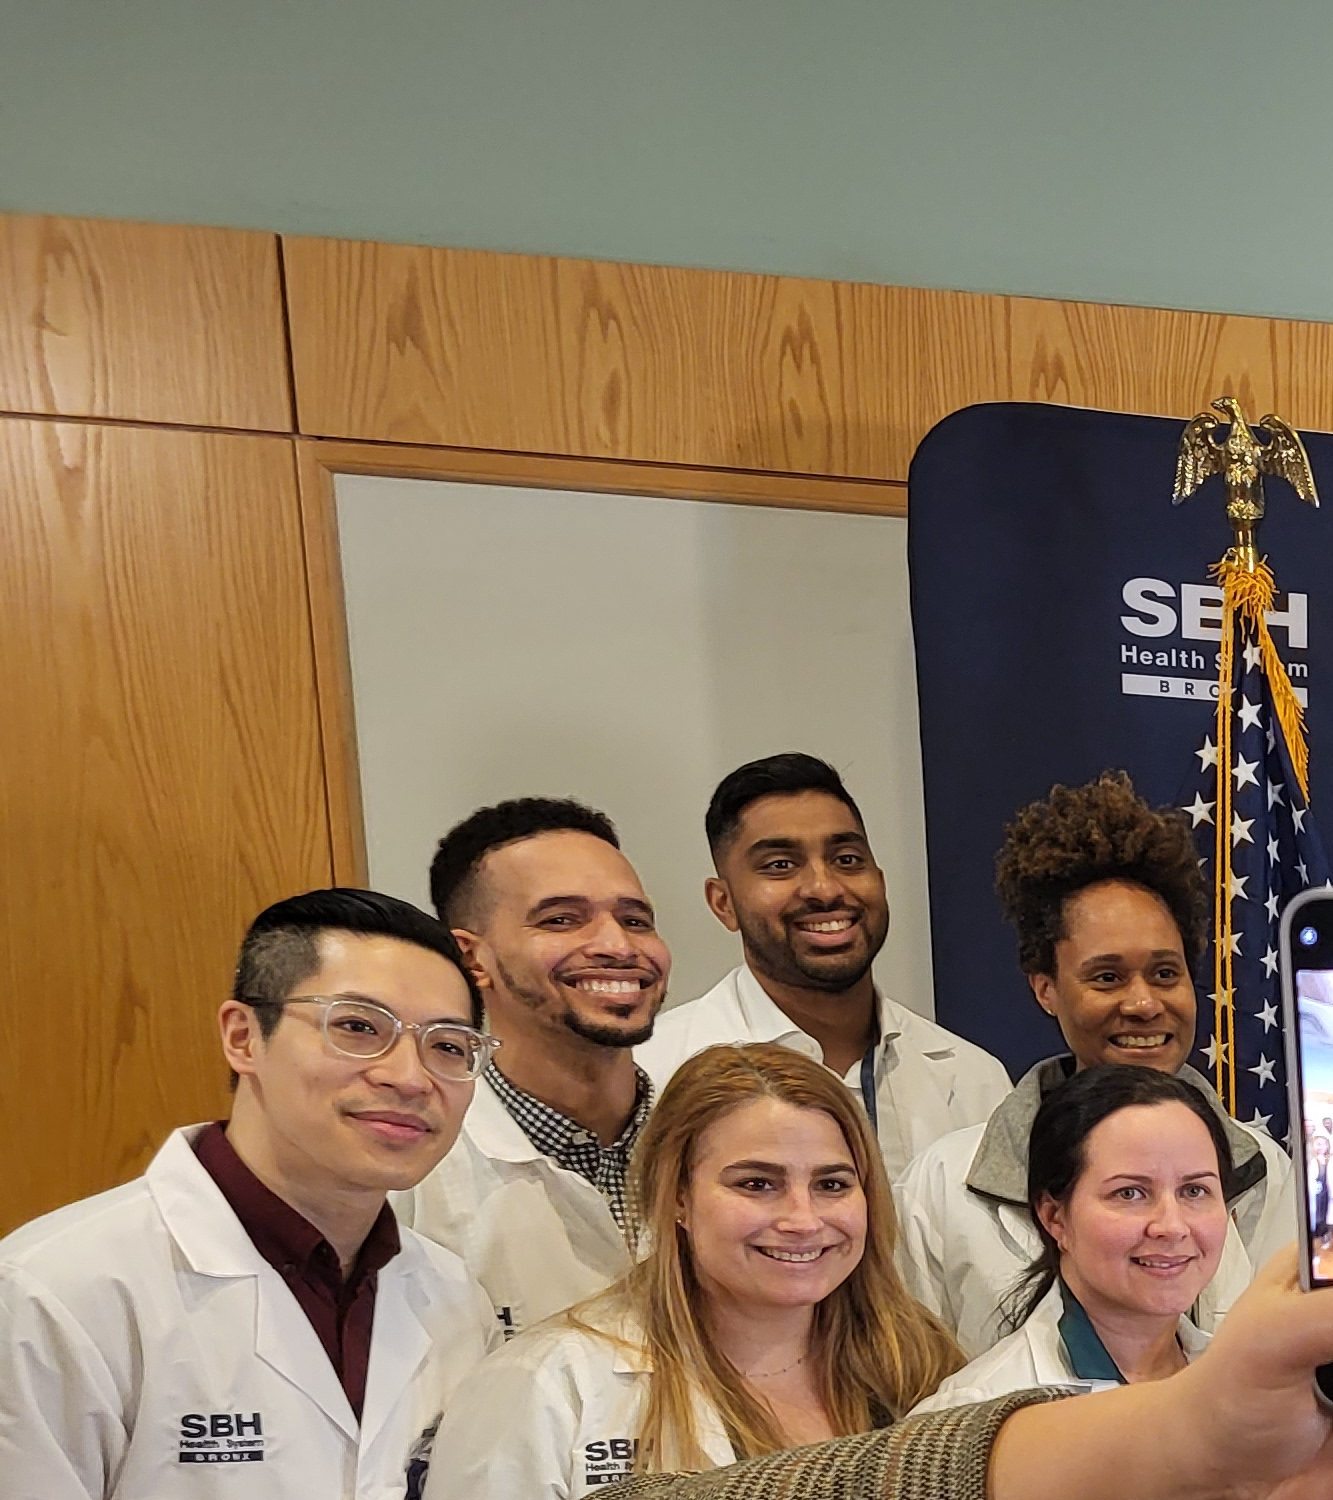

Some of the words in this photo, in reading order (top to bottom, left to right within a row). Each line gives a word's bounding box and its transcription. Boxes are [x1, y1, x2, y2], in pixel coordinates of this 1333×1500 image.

[1121, 644, 1205, 670] Health
[1159, 680, 1220, 698] BRO
[180, 1412, 263, 1438] SBH
